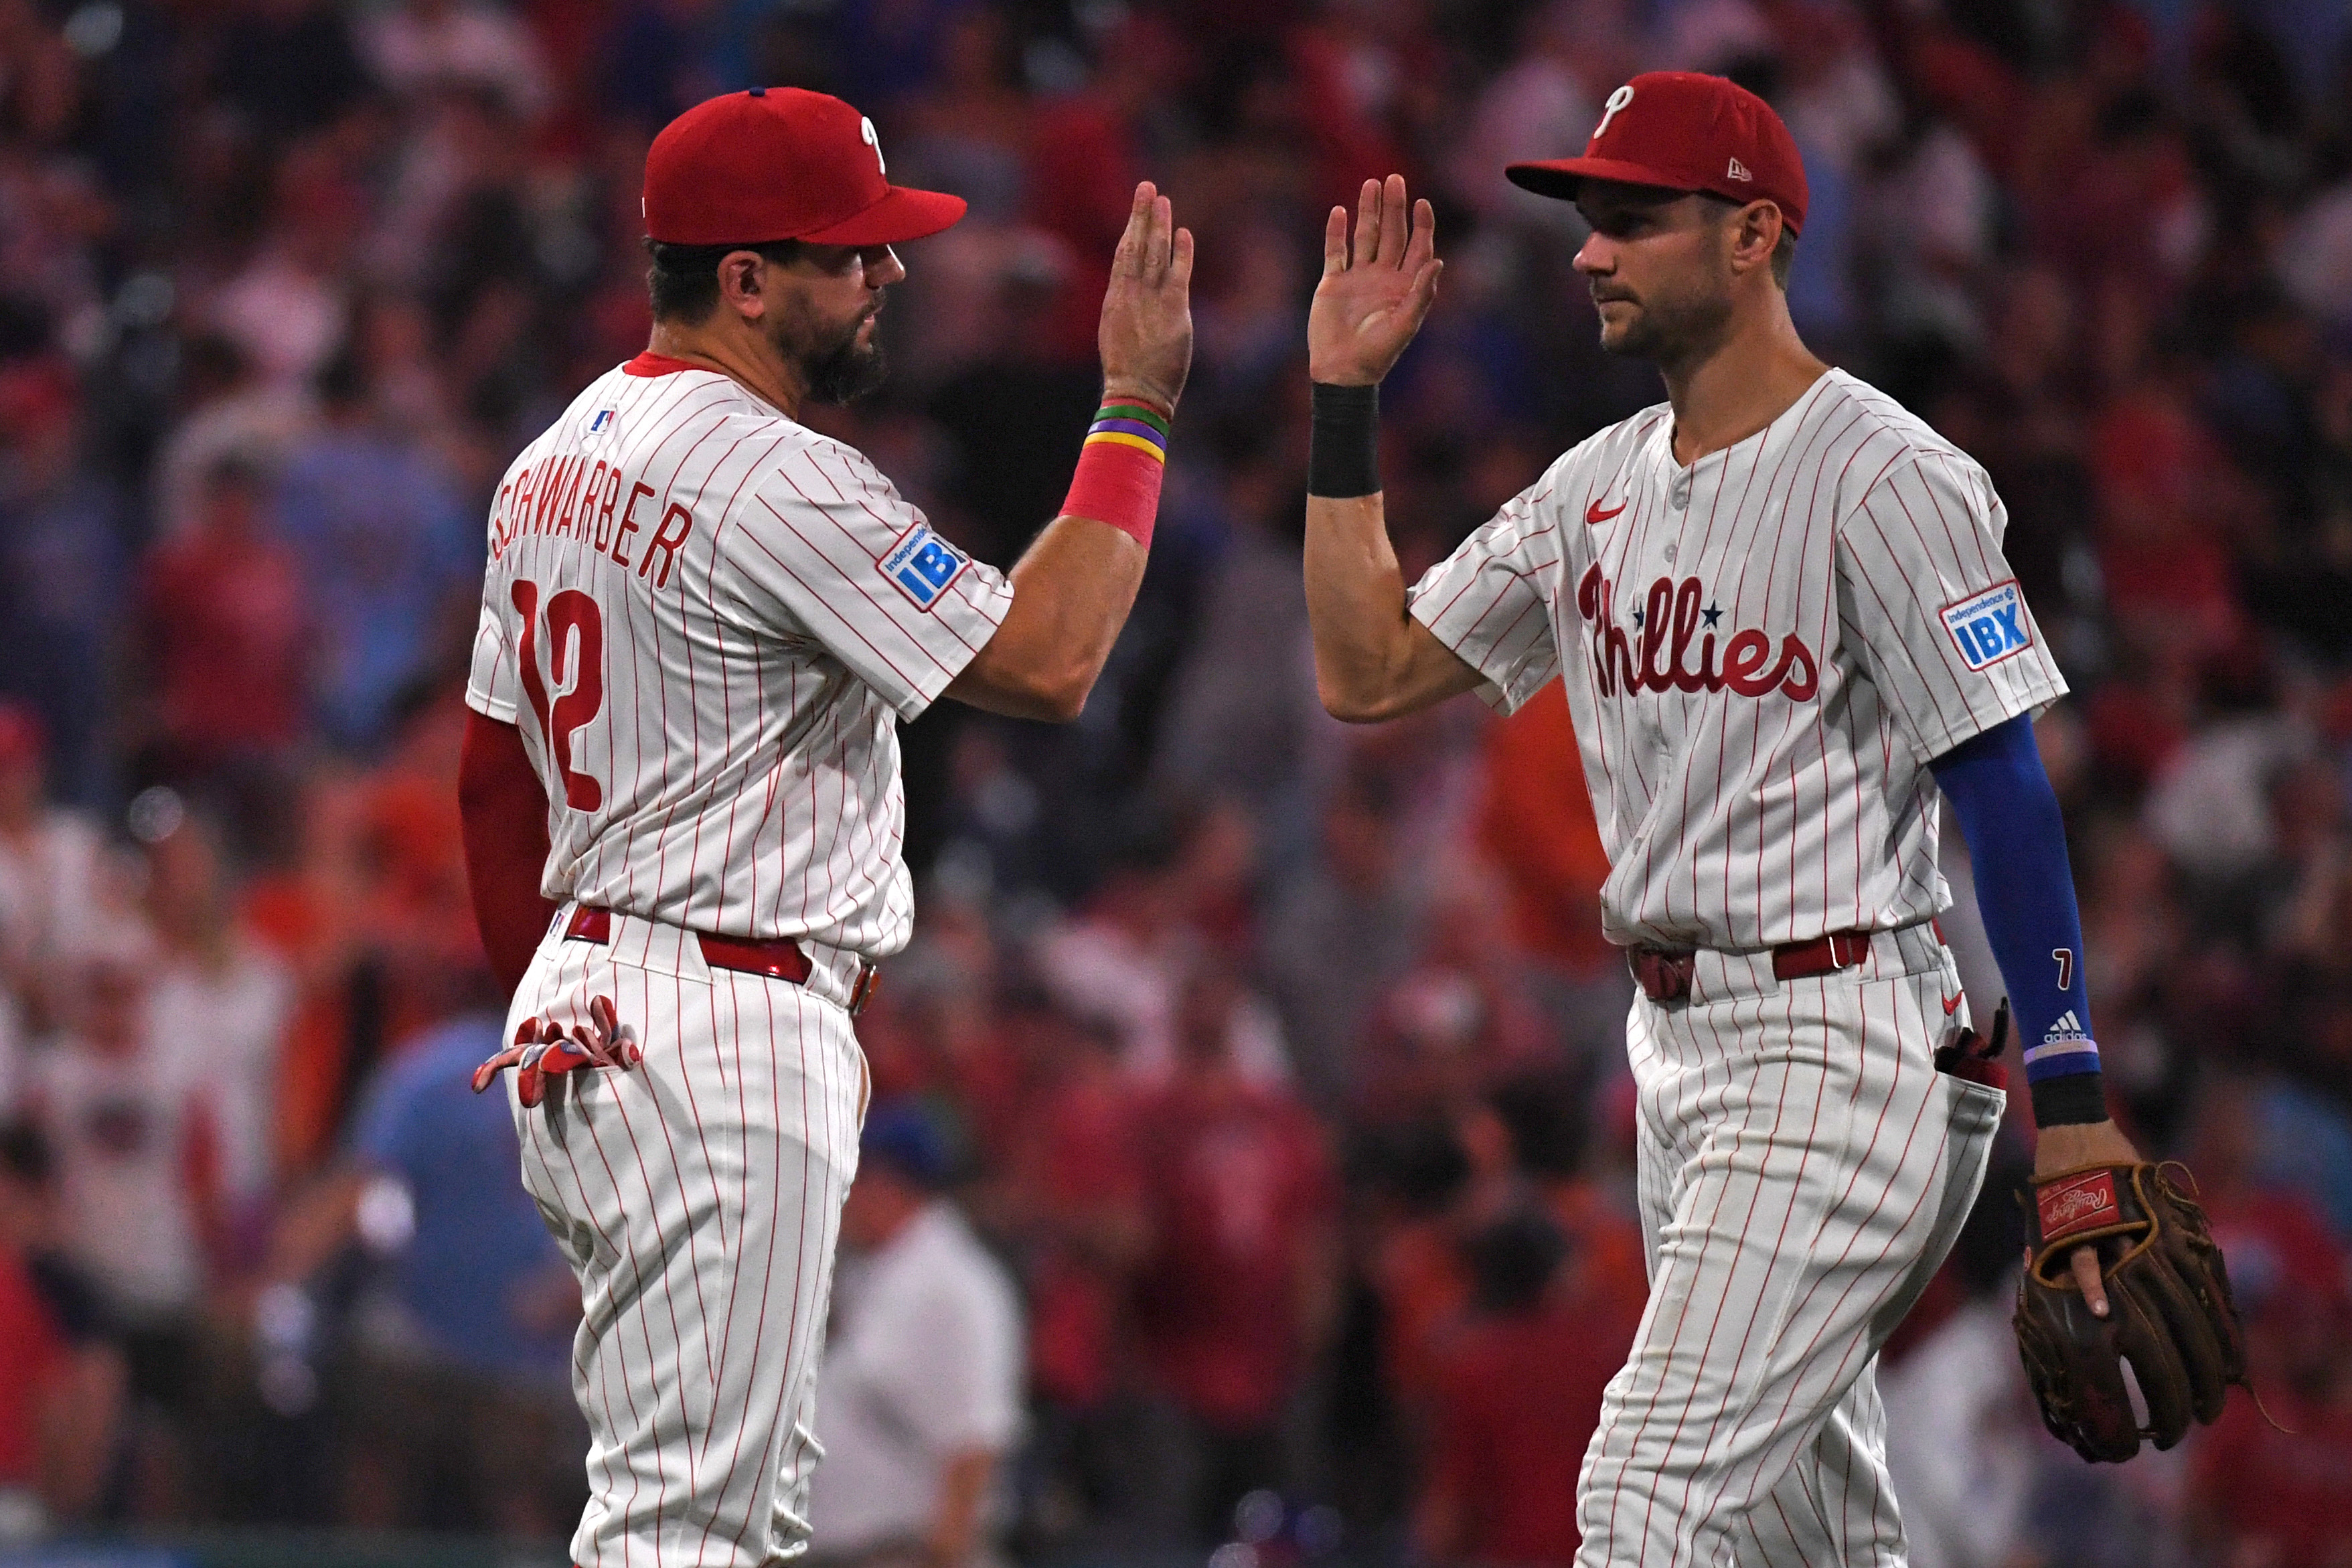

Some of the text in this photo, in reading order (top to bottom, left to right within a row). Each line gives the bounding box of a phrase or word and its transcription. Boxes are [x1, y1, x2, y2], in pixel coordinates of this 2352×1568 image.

[1593, 86, 1634, 139] P
[492, 455, 692, 590] SCHWARBER
[884, 526, 928, 572] Independ
[896, 537, 966, 603] IB
[1578, 561, 1818, 702] Phillies
[1947, 593, 2004, 624] Independence
[1954, 603, 2026, 665] IBX
[512, 579, 603, 813] 12
[2052, 948, 2072, 991] 7
[2044, 1029, 2088, 1044] adidas
[2045, 1188, 2108, 1223] Rawlings
